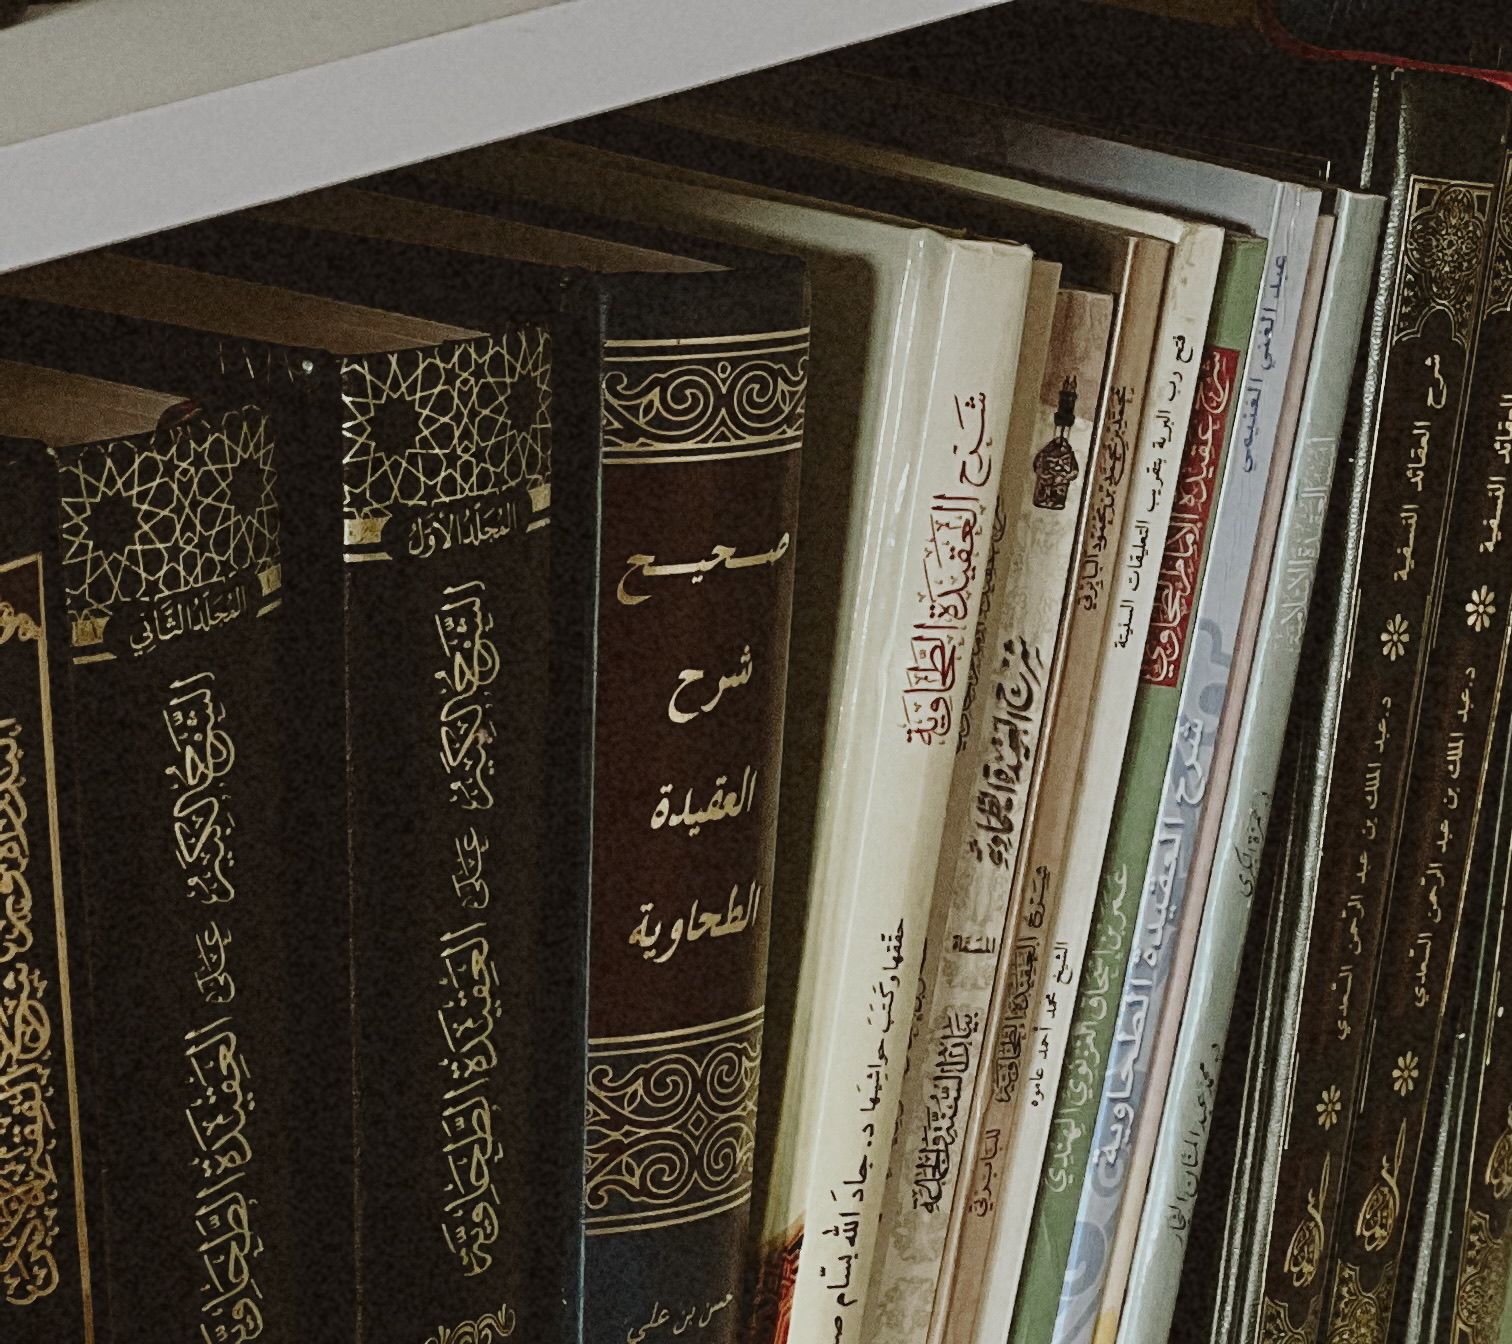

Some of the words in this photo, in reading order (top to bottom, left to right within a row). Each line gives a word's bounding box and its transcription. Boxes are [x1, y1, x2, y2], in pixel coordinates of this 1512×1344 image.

[1268, 254, 1289, 299] عبد
[1171, 333, 1195, 365] فتح
[1247, 306, 1287, 370] الغني
[1167, 370, 1185, 401] رب
[1188, 350, 1231, 415] شرح
[1423, 353, 1449, 409] شرح
[951, 390, 994, 489] شرح
[1150, 409, 1174, 449] البرية
[1226, 377, 1264, 473] الغنيمي
[1405, 420, 1432, 491] العقائد
[1145, 457, 1165, 512] بتقريب
[1179, 415, 1221, 503] عقيدة
[1392, 503, 1420, 581] النسفية
[1478, 475, 1507, 553] النسفية
[617, 528, 791, 606] صحيح
[1127, 519, 1151, 591] التعليقات
[668, 643, 753, 723] شرح
[1178, 718, 1221, 803] شرح
[1363, 761, 1382, 809] الملك
[1445, 732, 1465, 779] الملك
[650, 766, 757, 838] العقيدة
[1360, 816, 1379, 839] بن
[1442, 786, 1460, 809] بن
[1355, 850, 1369, 883] عبد
[1435, 819, 1454, 853] عبد
[1098, 862, 1129, 919] عمر
[1133, 819, 1188, 967] العقيدة
[1419, 861, 1446, 922] الرحمن
[628, 880, 762, 964] الطحاوية
[1340, 893, 1366, 955] الرحمن
[1052, 940, 1075, 985] الشيخ
[1407, 932, 1433, 1007] السعدي
[1043, 991, 1058, 1019] محمد
[1329, 964, 1354, 1040] السعدي
[1027, 1025, 1051, 1062] أحمد
[1089, 976, 1154, 1166] الطحاوية
[1027, 1067, 1046, 1107] عاموه
[1038, 1106, 1083, 1193] الهندي
[673, 1304, 697, 1336] بن
[699, 1293, 733, 1329] حسن
